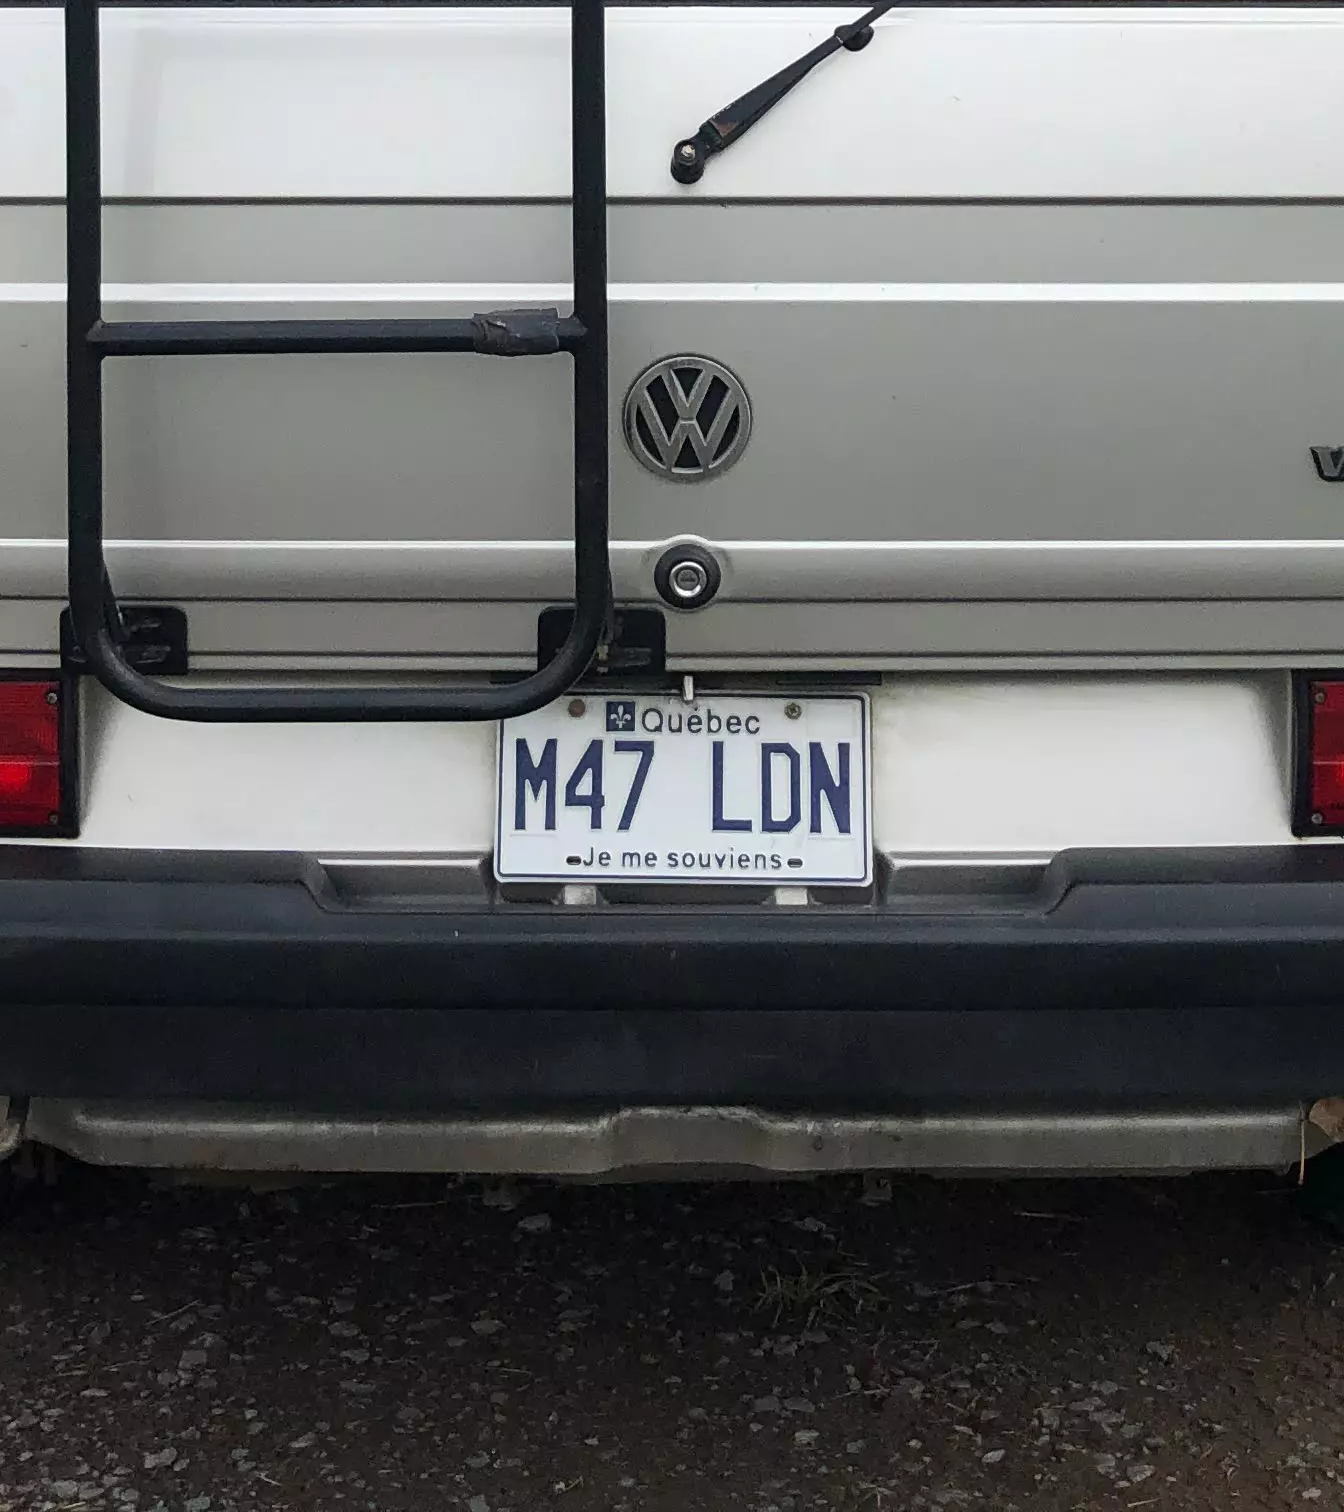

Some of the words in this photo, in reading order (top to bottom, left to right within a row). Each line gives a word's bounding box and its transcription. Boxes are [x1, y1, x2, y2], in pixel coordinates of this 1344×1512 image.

[628, 359, 747, 478] VW
[641, 705, 761, 734] Québec
[514, 737, 655, 831] M47
[712, 740, 851, 835] LDN
[583, 847, 611, 867] Je
[622, 850, 657, 868] me
[667, 846, 782, 869] souviens
